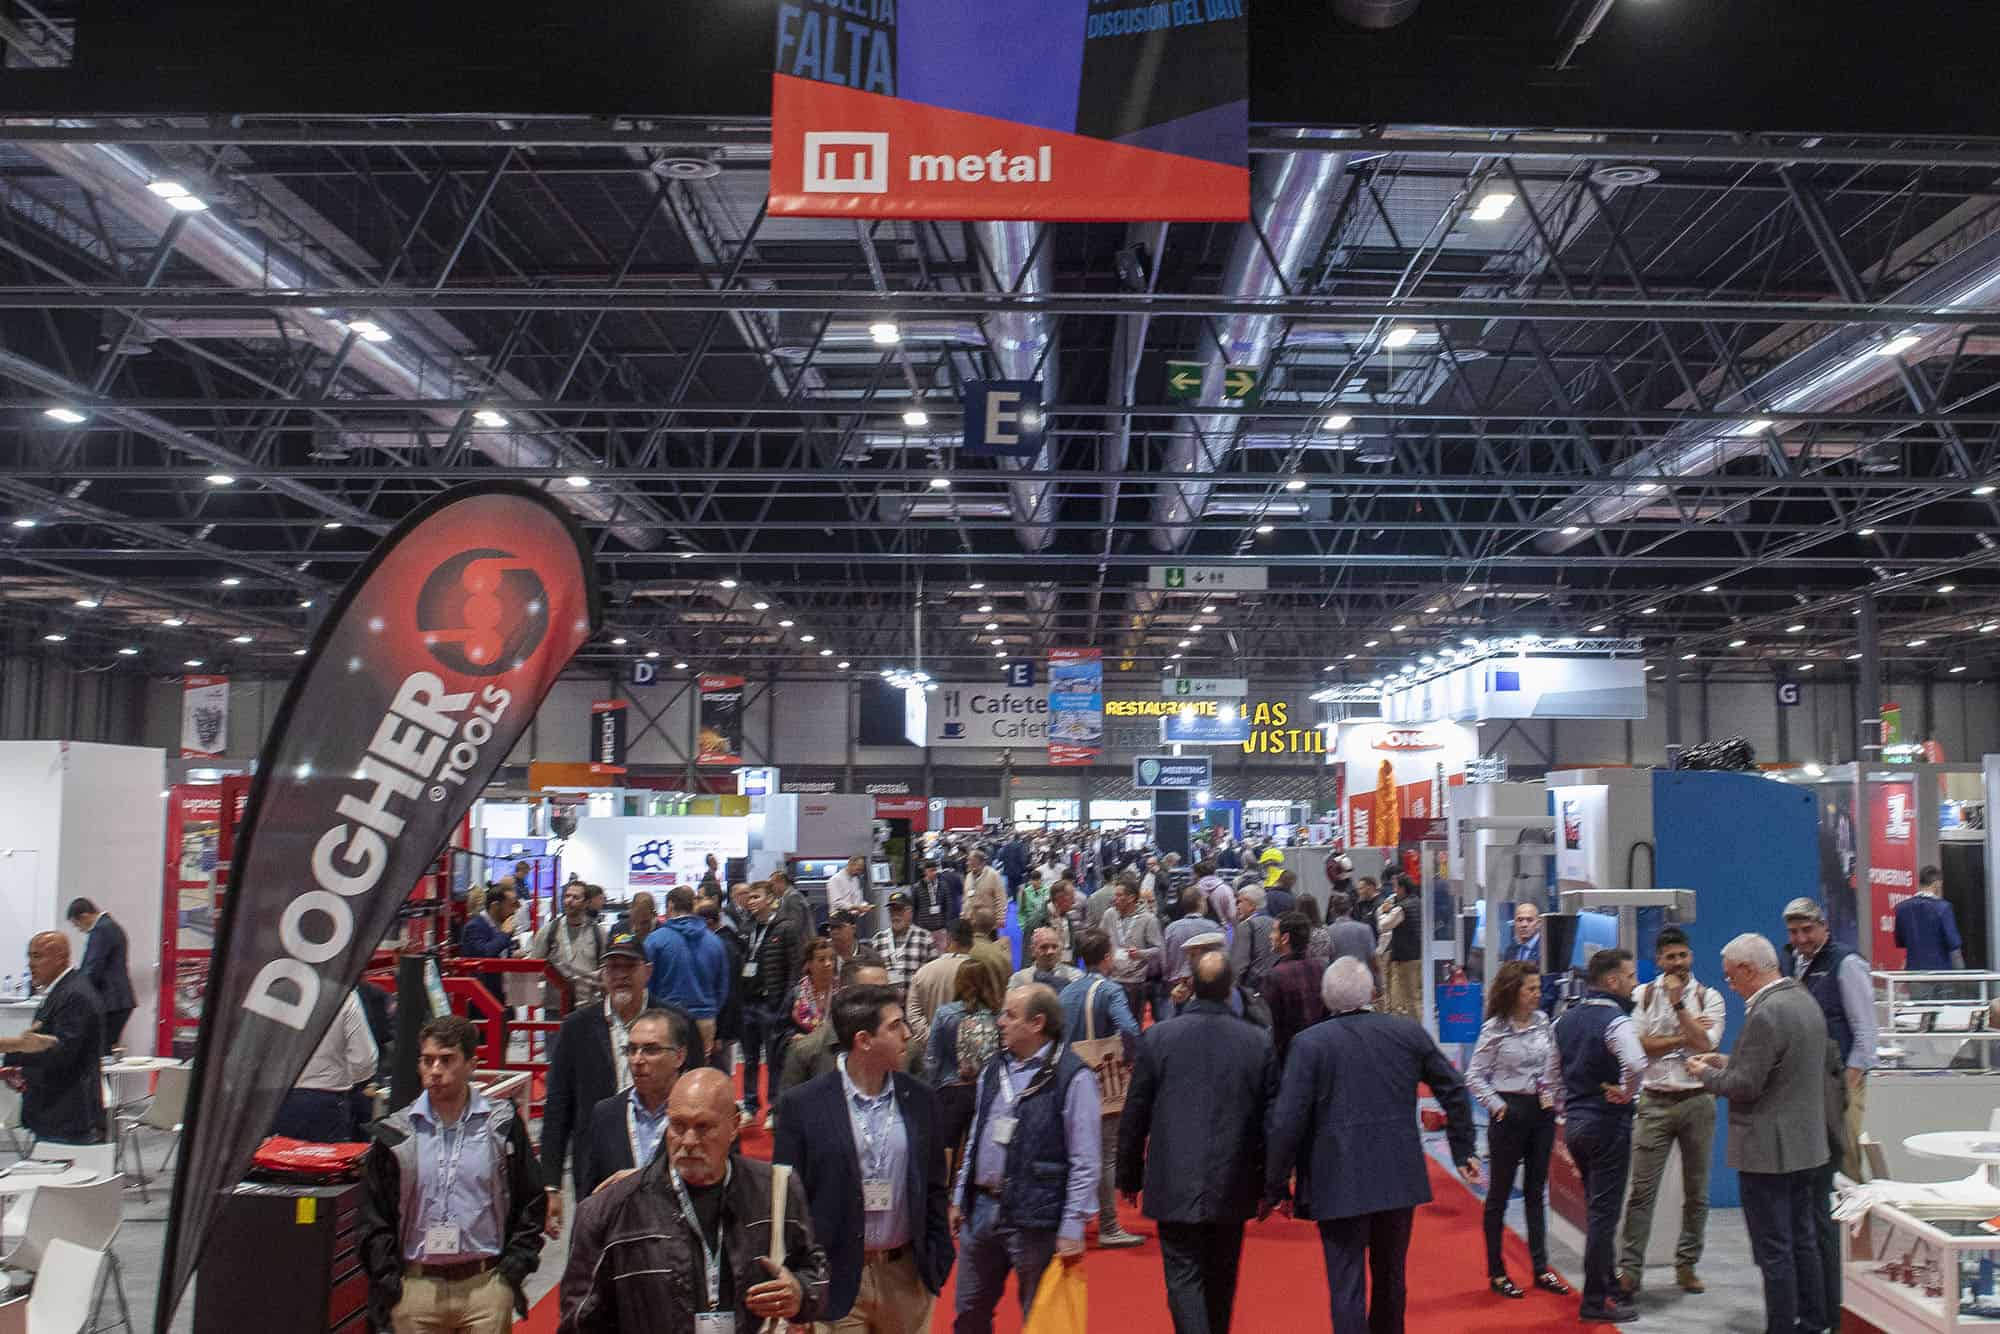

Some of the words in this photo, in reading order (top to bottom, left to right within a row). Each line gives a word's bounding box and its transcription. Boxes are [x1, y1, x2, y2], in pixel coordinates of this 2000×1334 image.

[776, 4, 895, 97] FALTA
[908, 145, 1052, 183] metal
[984, 391, 1021, 445] E
[634, 663, 654, 683] D
[1014, 664, 1029, 685] E
[1105, 701, 1218, 716] RESTAURANTE
[1779, 684, 1797, 703] G
[437, 684, 512, 786] TOOLS
[242, 671, 476, 1031] DOGHER
